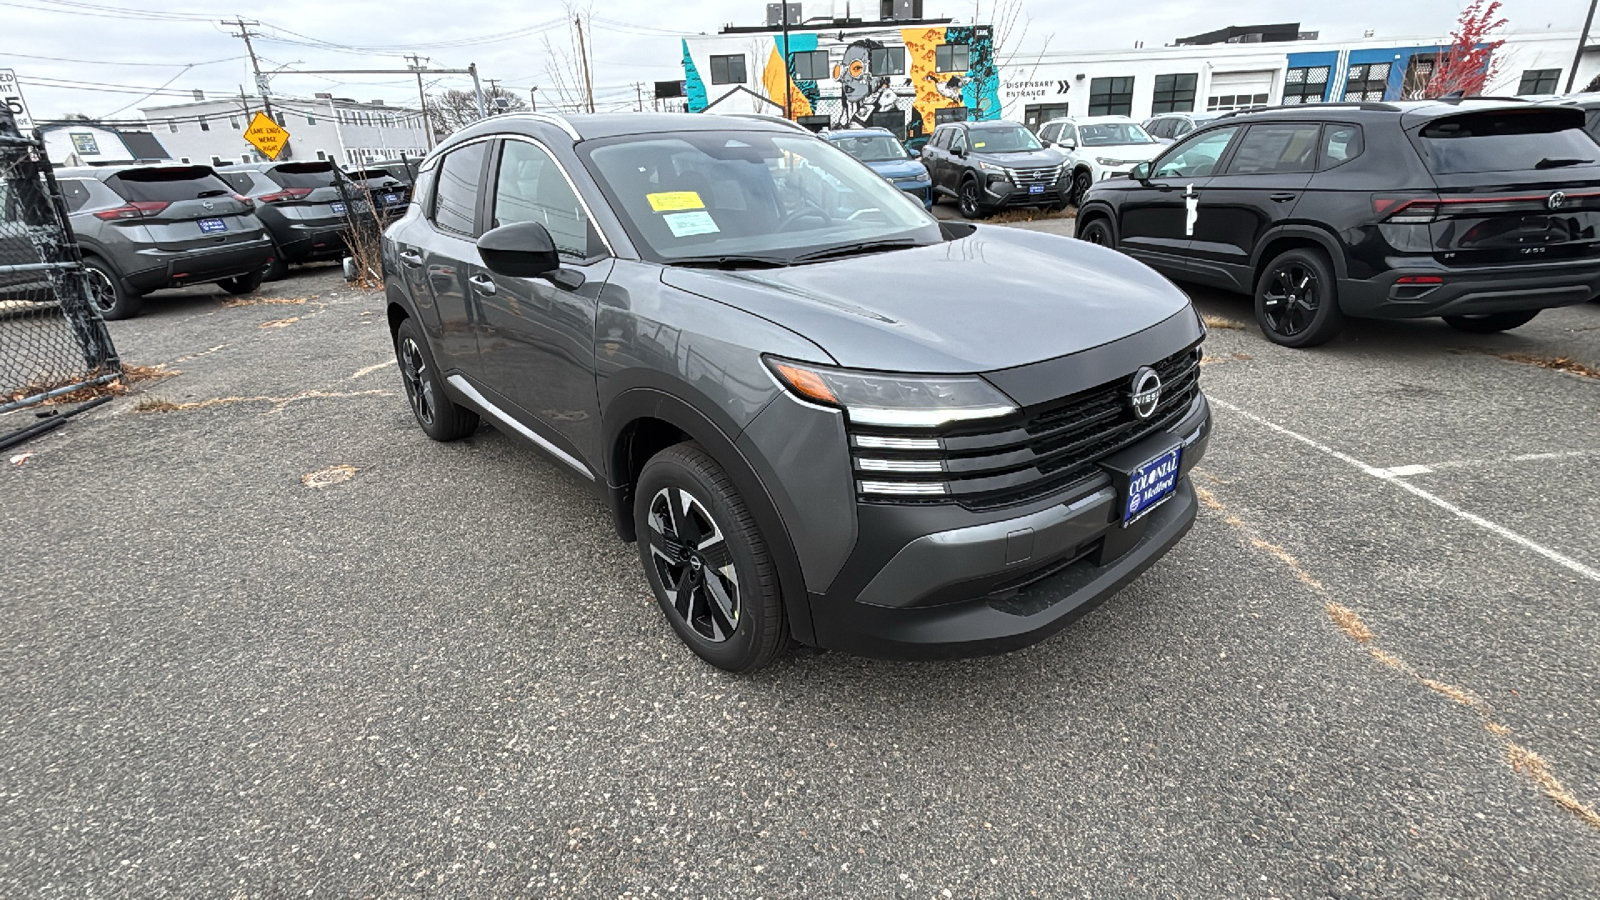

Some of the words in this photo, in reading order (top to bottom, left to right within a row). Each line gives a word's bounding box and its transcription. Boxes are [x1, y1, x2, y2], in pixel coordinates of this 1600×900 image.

[1006, 80, 1054, 89] DISPENSARY
[1006, 90, 1046, 98] ENTRANCE
[5, 97, 23, 114] 5
[1143, 475, 1174, 502] Medford
